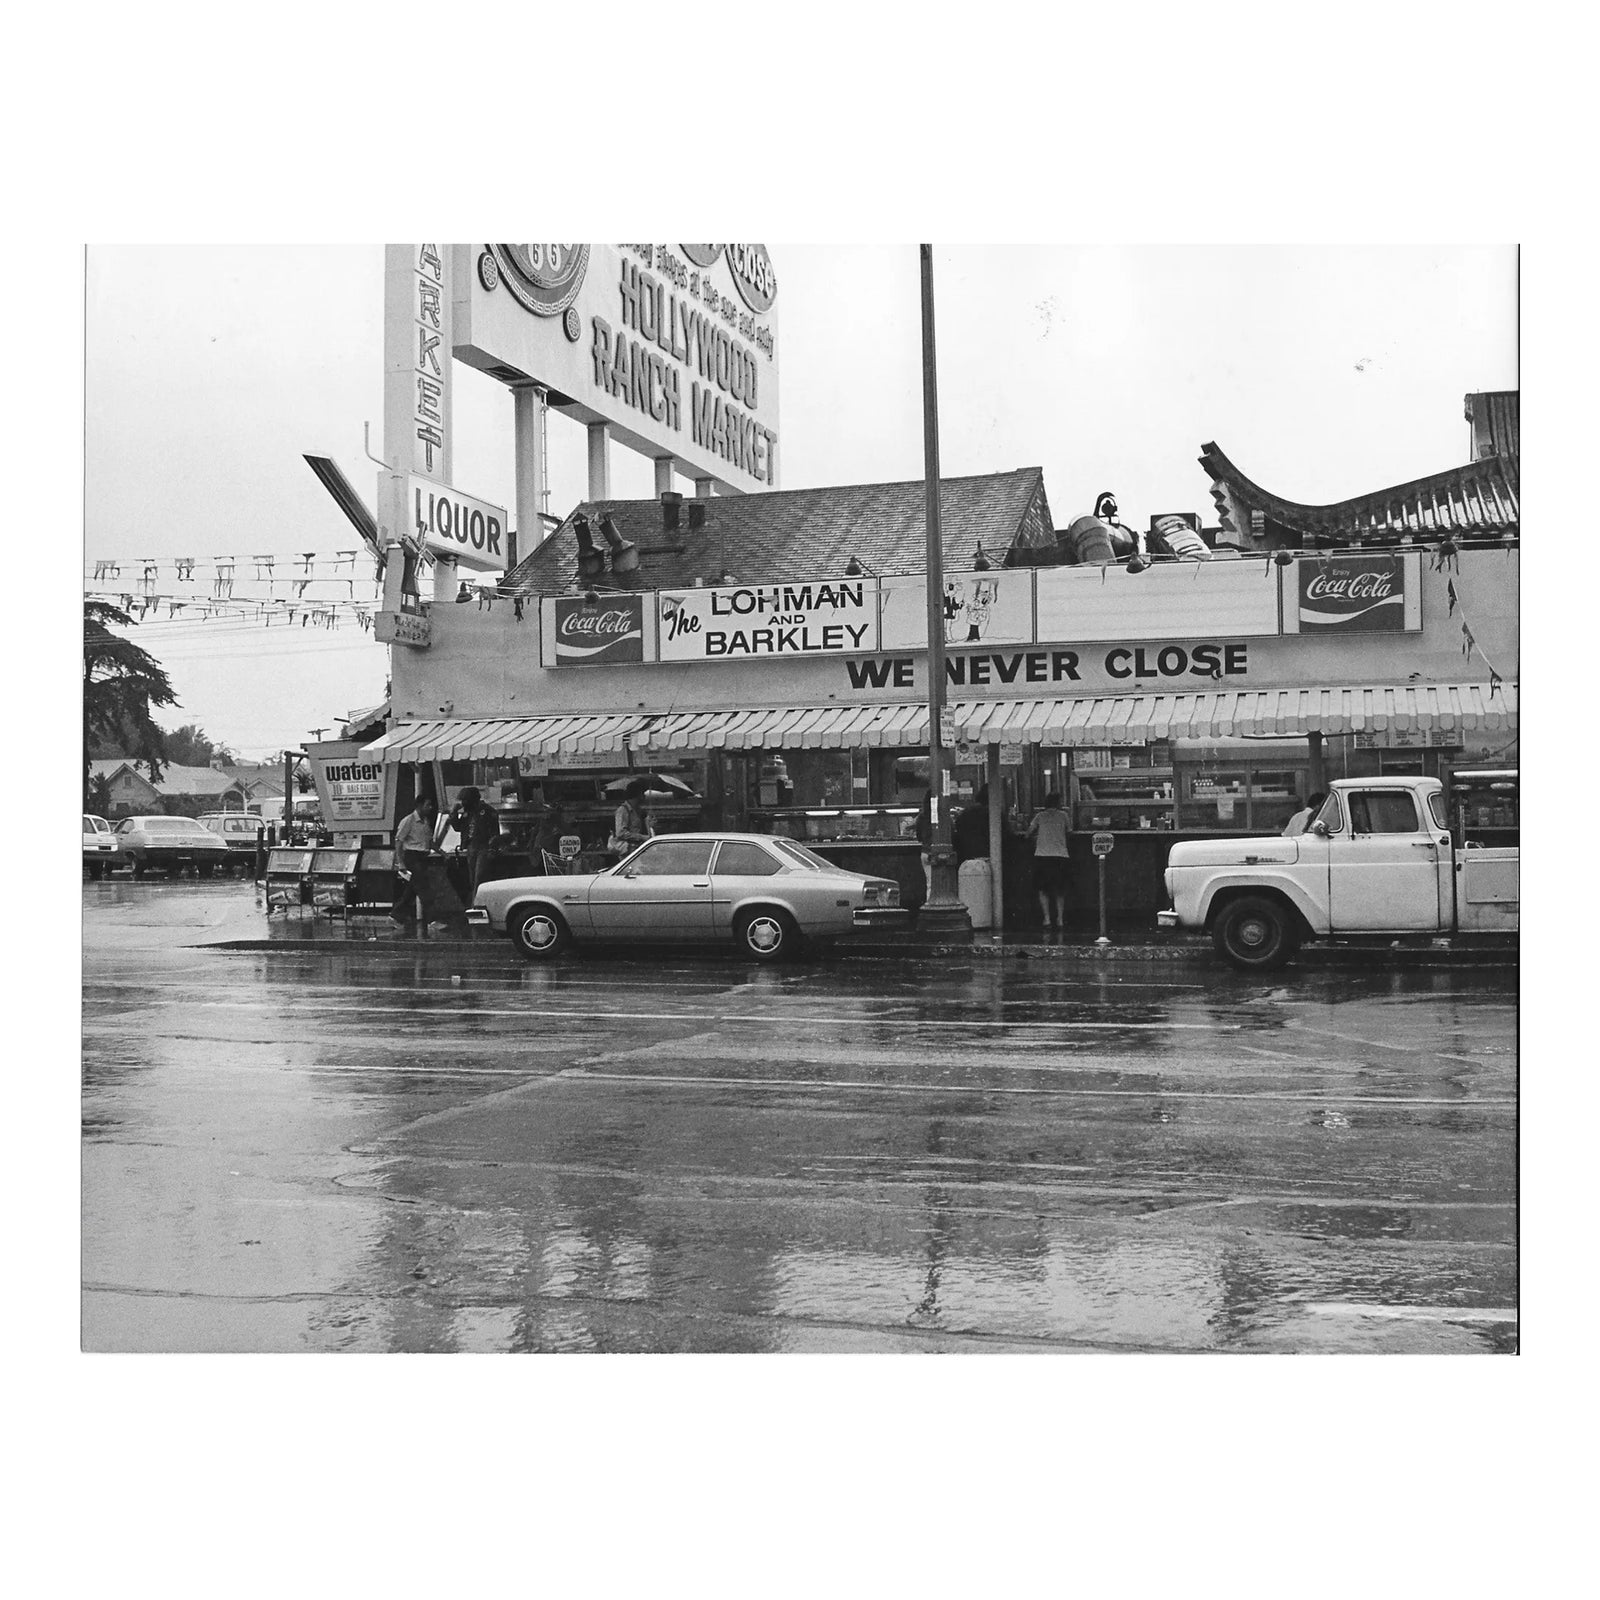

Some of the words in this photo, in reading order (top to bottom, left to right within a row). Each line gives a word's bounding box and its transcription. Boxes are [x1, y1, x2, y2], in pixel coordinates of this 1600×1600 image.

[619, 257, 758, 410] HOLLYWOOD
[592, 315, 681, 432] RANCH
[692, 381, 777, 486] MARKET
[415, 487, 502, 556] LIQUOR
[711, 583, 864, 616] LOHMAN
[1306, 571, 1396, 600] Coca-Cola
[561, 609, 634, 636] Coca-Cola
[663, 608, 702, 641] The
[768, 614, 806, 626] AND
[705, 623, 869, 656] BARKLEY
[846, 658, 914, 689] WE
[945, 651, 1081, 686] NEVER
[1105, 644, 1248, 678] CLOSE
[326, 762, 382, 781] water
